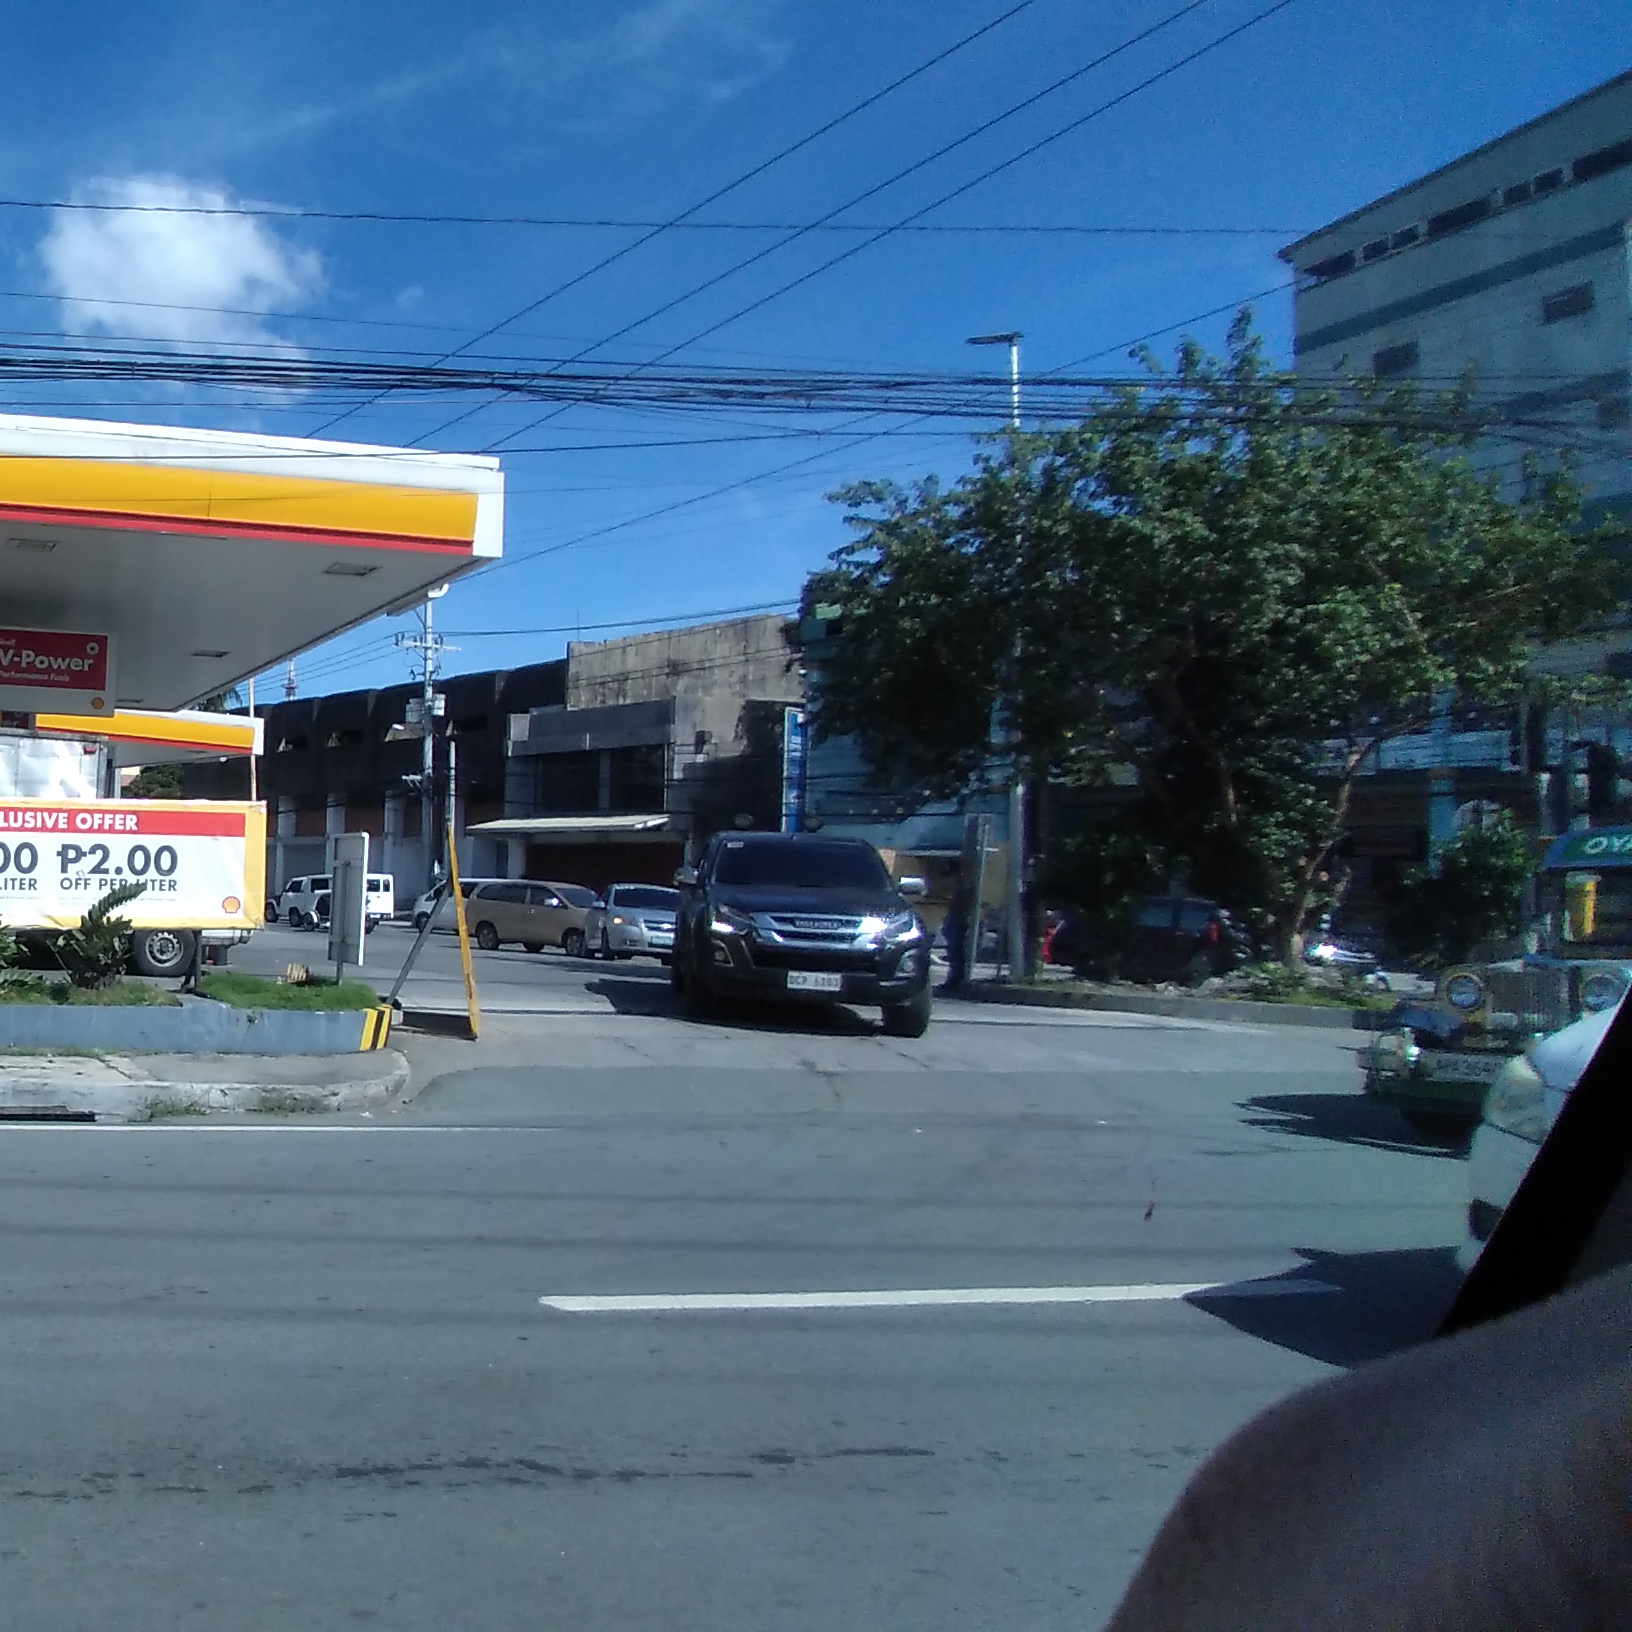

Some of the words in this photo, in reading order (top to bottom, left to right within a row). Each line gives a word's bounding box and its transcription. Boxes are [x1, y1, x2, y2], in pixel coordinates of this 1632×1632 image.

[50, 673, 70, 682] Fuels
[75, 812, 139, 831] OFFER
[60, 877, 91, 891] OFF
[98, 878, 128, 891] PER
